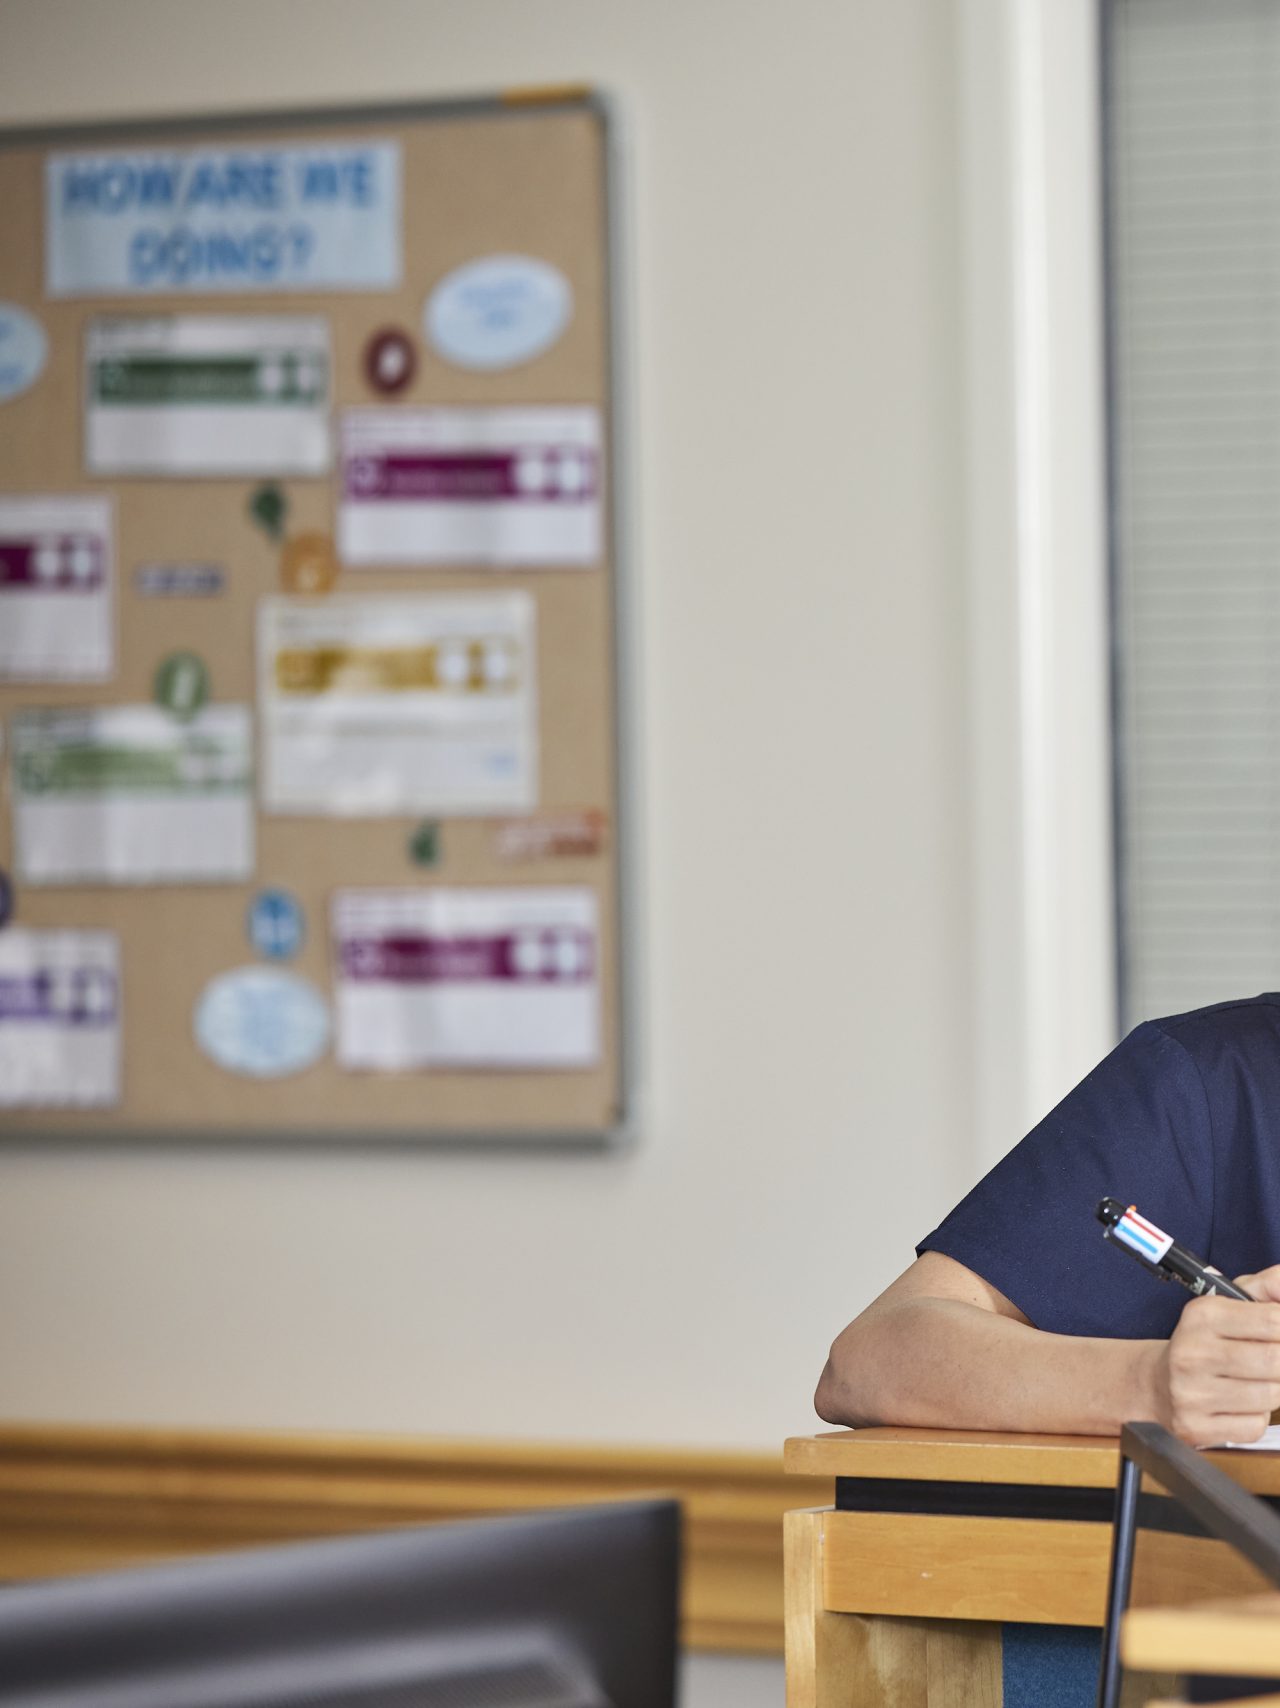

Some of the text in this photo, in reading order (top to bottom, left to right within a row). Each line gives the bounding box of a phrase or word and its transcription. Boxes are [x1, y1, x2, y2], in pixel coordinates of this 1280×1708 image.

[64, 151, 377, 214] HOW ARE WE
[128, 226, 315, 285] DOING?
